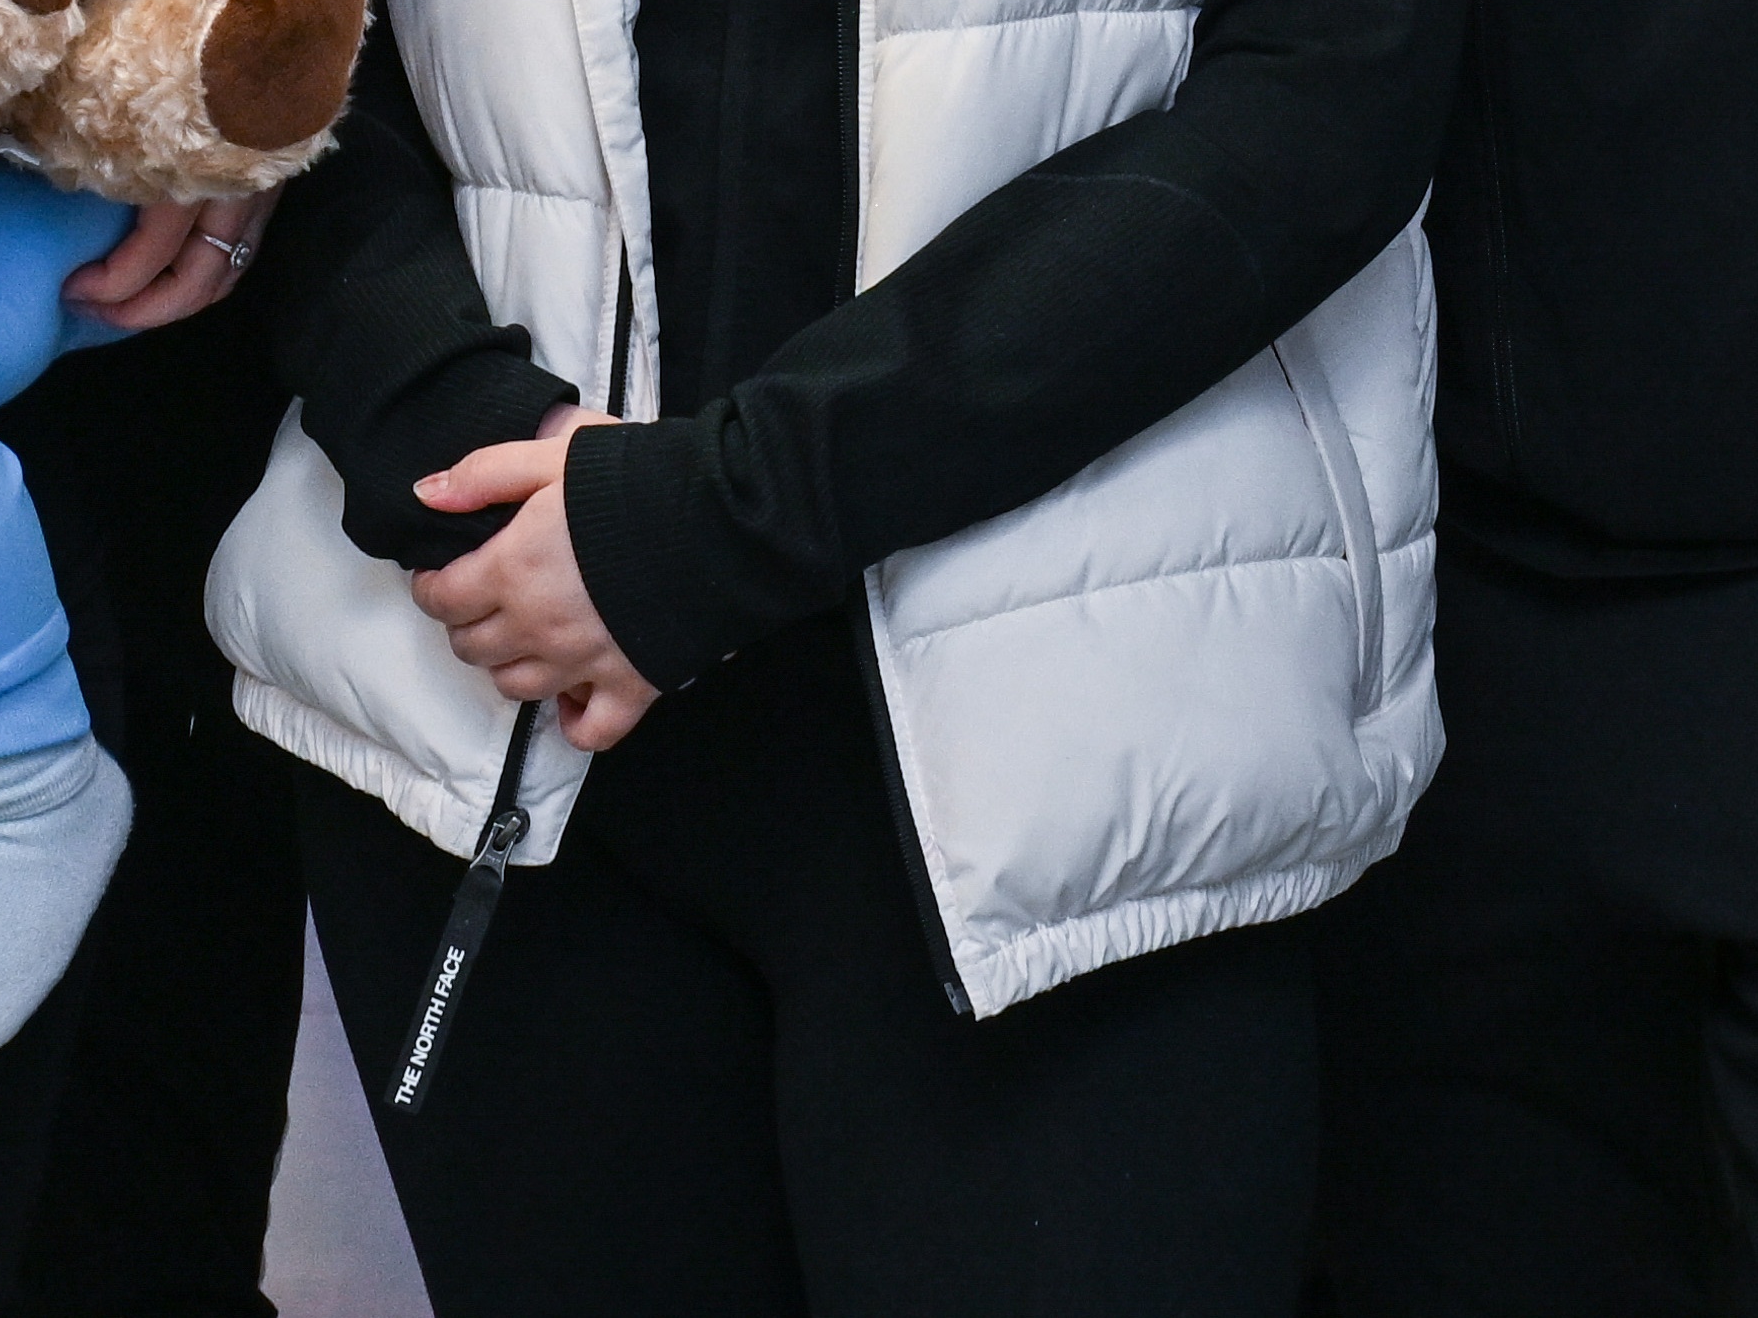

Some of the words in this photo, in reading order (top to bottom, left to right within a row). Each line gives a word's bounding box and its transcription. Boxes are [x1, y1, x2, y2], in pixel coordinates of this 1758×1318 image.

[394, 1065, 423, 1105] THE
[410, 996, 447, 1067] NORTH
[434, 945, 466, 999] FACE
